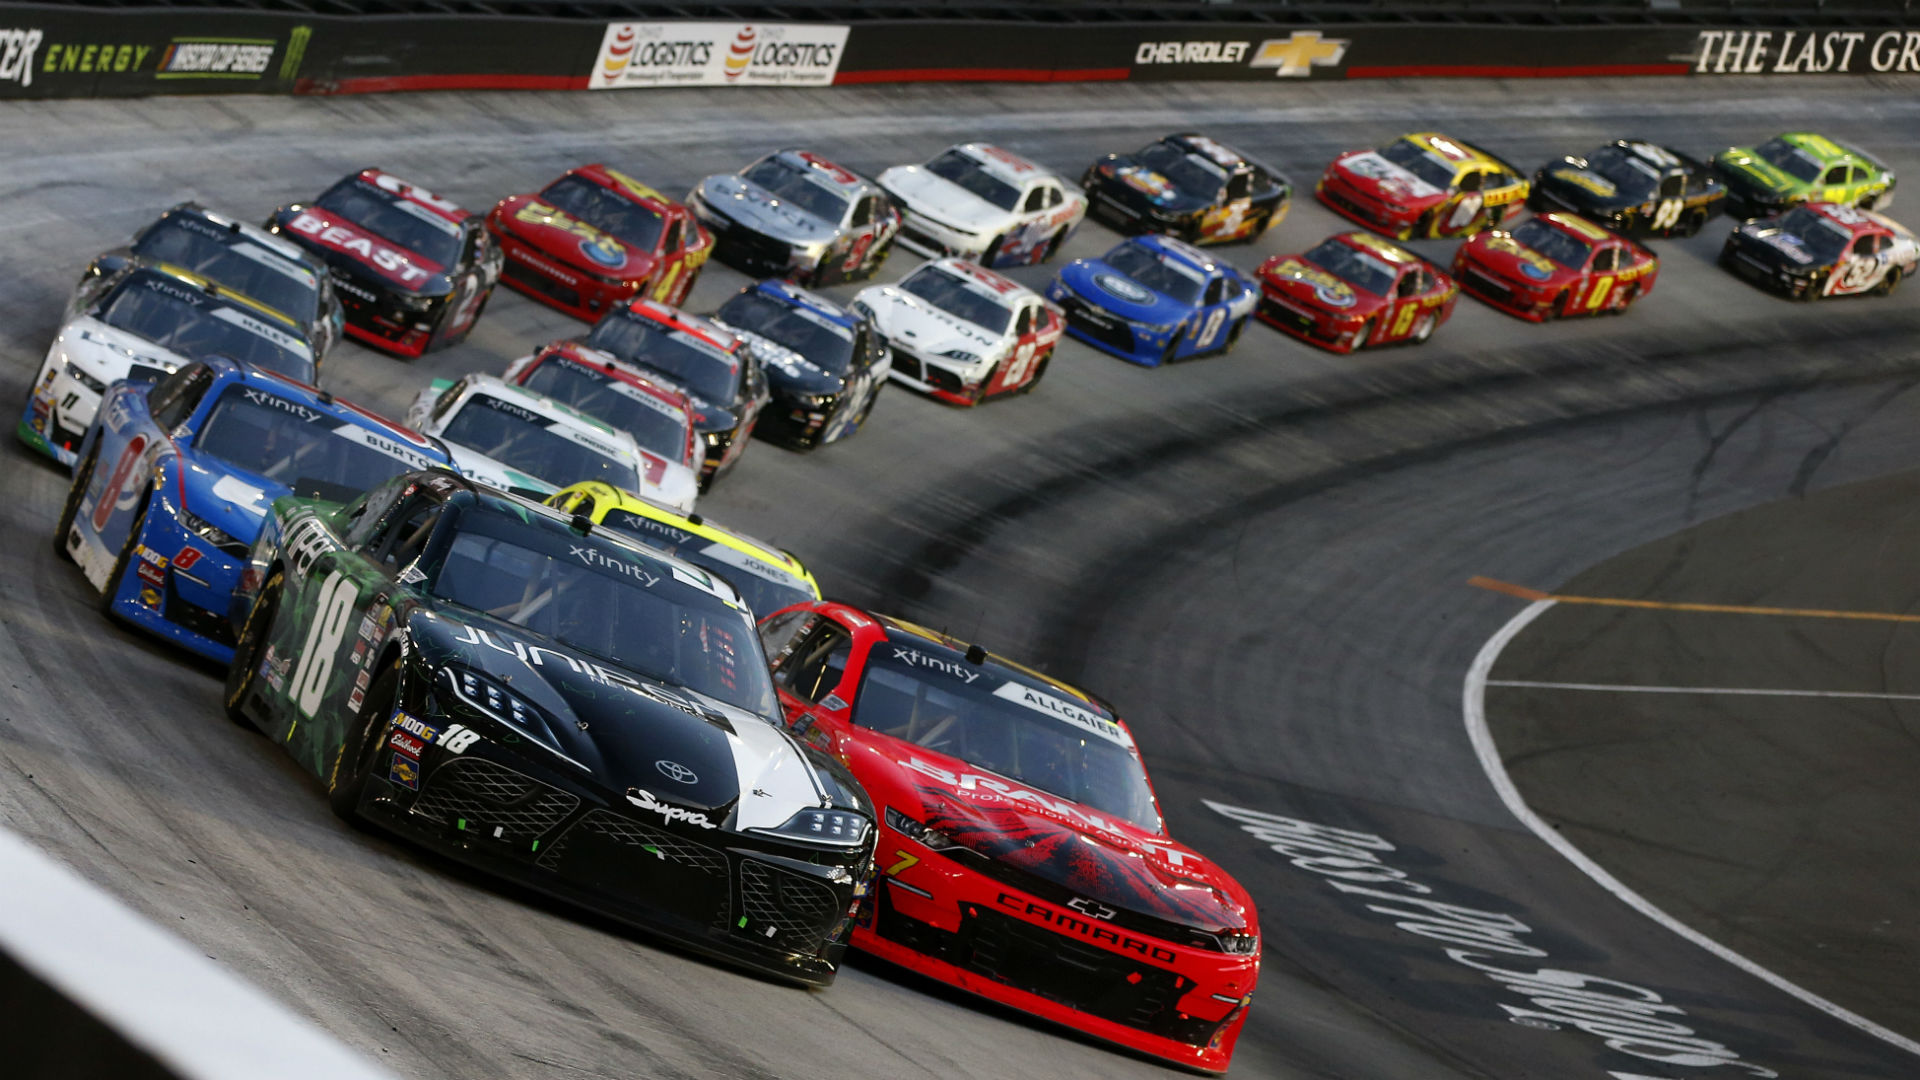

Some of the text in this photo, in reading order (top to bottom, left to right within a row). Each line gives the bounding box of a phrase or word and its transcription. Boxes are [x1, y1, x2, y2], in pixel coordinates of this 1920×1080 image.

[42, 44, 151, 73] ENERGY
[630, 42, 714, 67] LOGISTICS
[752, 42, 836, 67] LOGISTICS
[1135, 41, 1250, 64] CHEVROLET
[1696, 30, 1773, 73] THE
[1773, 30, 1865, 73] LAST
[291, 213, 429, 282] BEAST
[144, 277, 203, 307] xfinity
[240, 315, 294, 346] HALEY
[556, 356, 602, 380] xfinity
[243, 386, 322, 424] xfinity
[486, 397, 538, 423] xfinity
[573, 431, 619, 458] CINDRIC
[622, 513, 693, 545] xfinity
[172, 546, 203, 571] 8
[568, 543, 662, 589] xfinity
[738, 556, 790, 585] JONES
[288, 568, 361, 719] 18
[893, 646, 980, 684] xfinity
[1022, 691, 1121, 740] ALLGAIER
[436, 723, 481, 755] 18
[625, 787, 718, 830] Supra
[897, 756, 1203, 867] BRANDT
[885, 849, 921, 876] 7
[996, 893, 1177, 964] CAMARO
